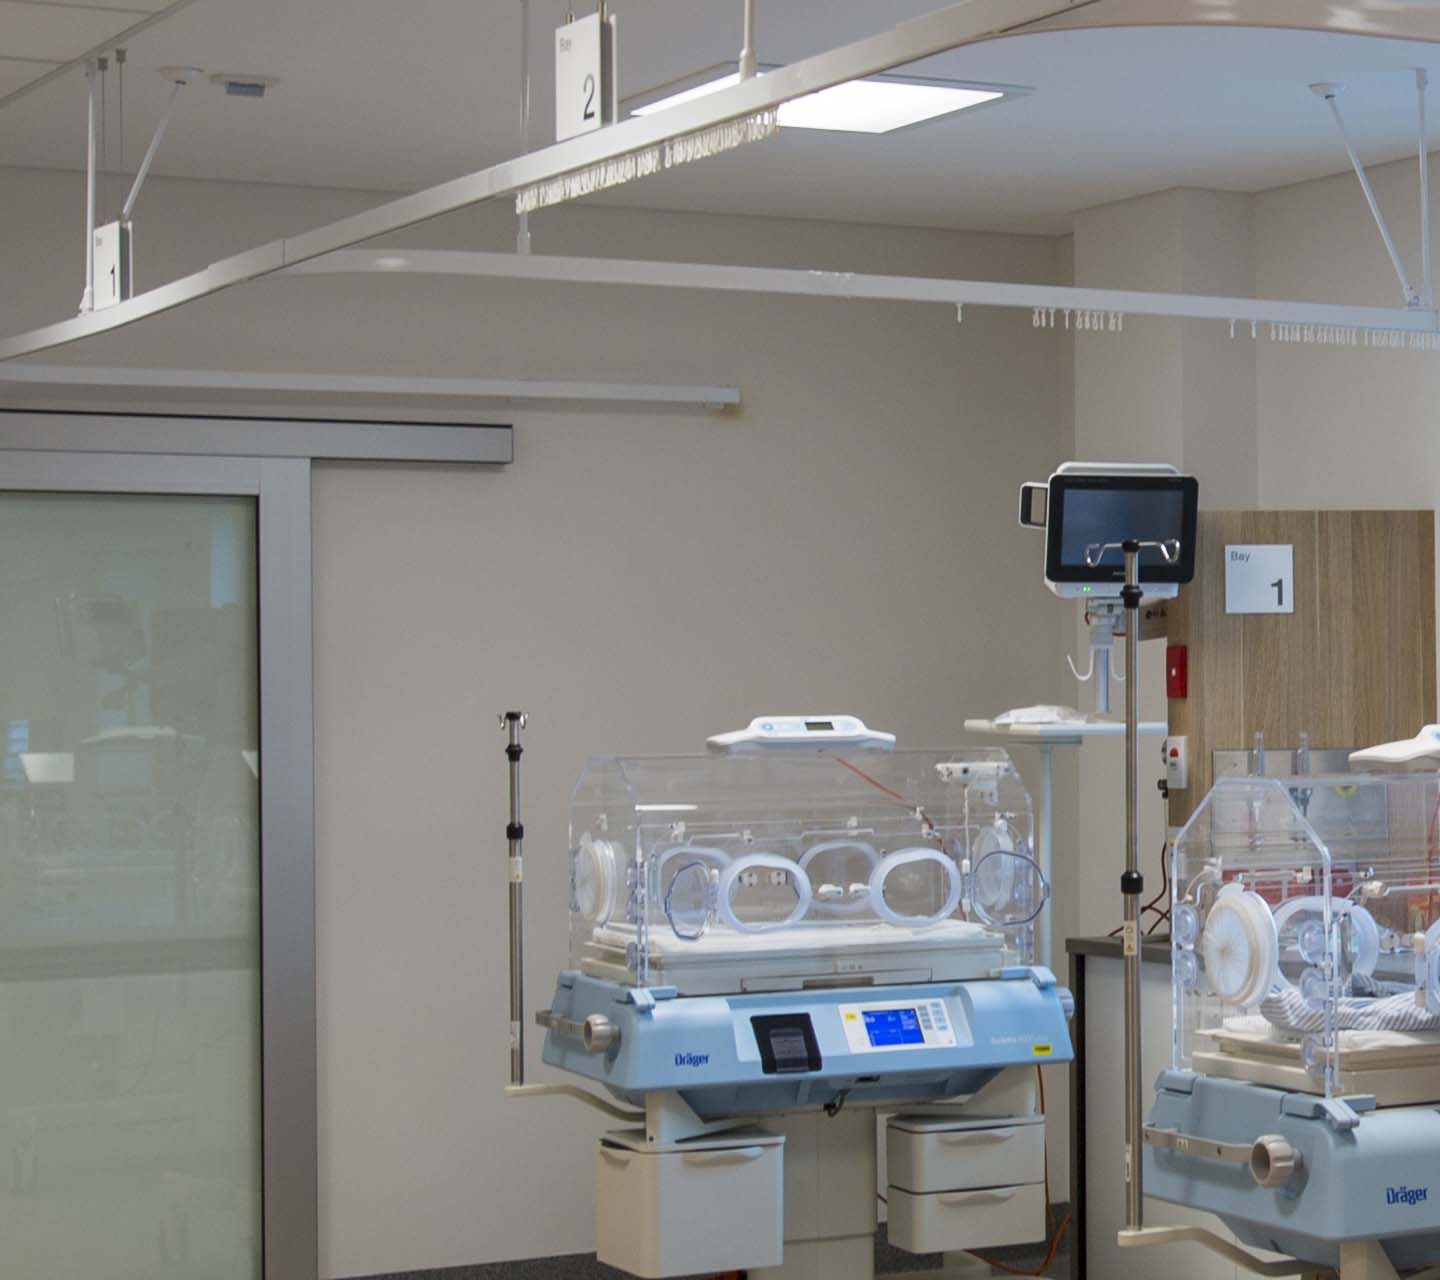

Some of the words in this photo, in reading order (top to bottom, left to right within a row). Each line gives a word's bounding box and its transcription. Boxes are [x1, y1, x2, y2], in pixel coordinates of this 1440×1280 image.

[583, 73, 596, 120] 2
[1230, 551, 1251, 563] Bay
[1271, 578, 1283, 606] 1
[675, 1052, 710, 1067] Dräger
[1386, 1186, 1428, 1206] Dräger
